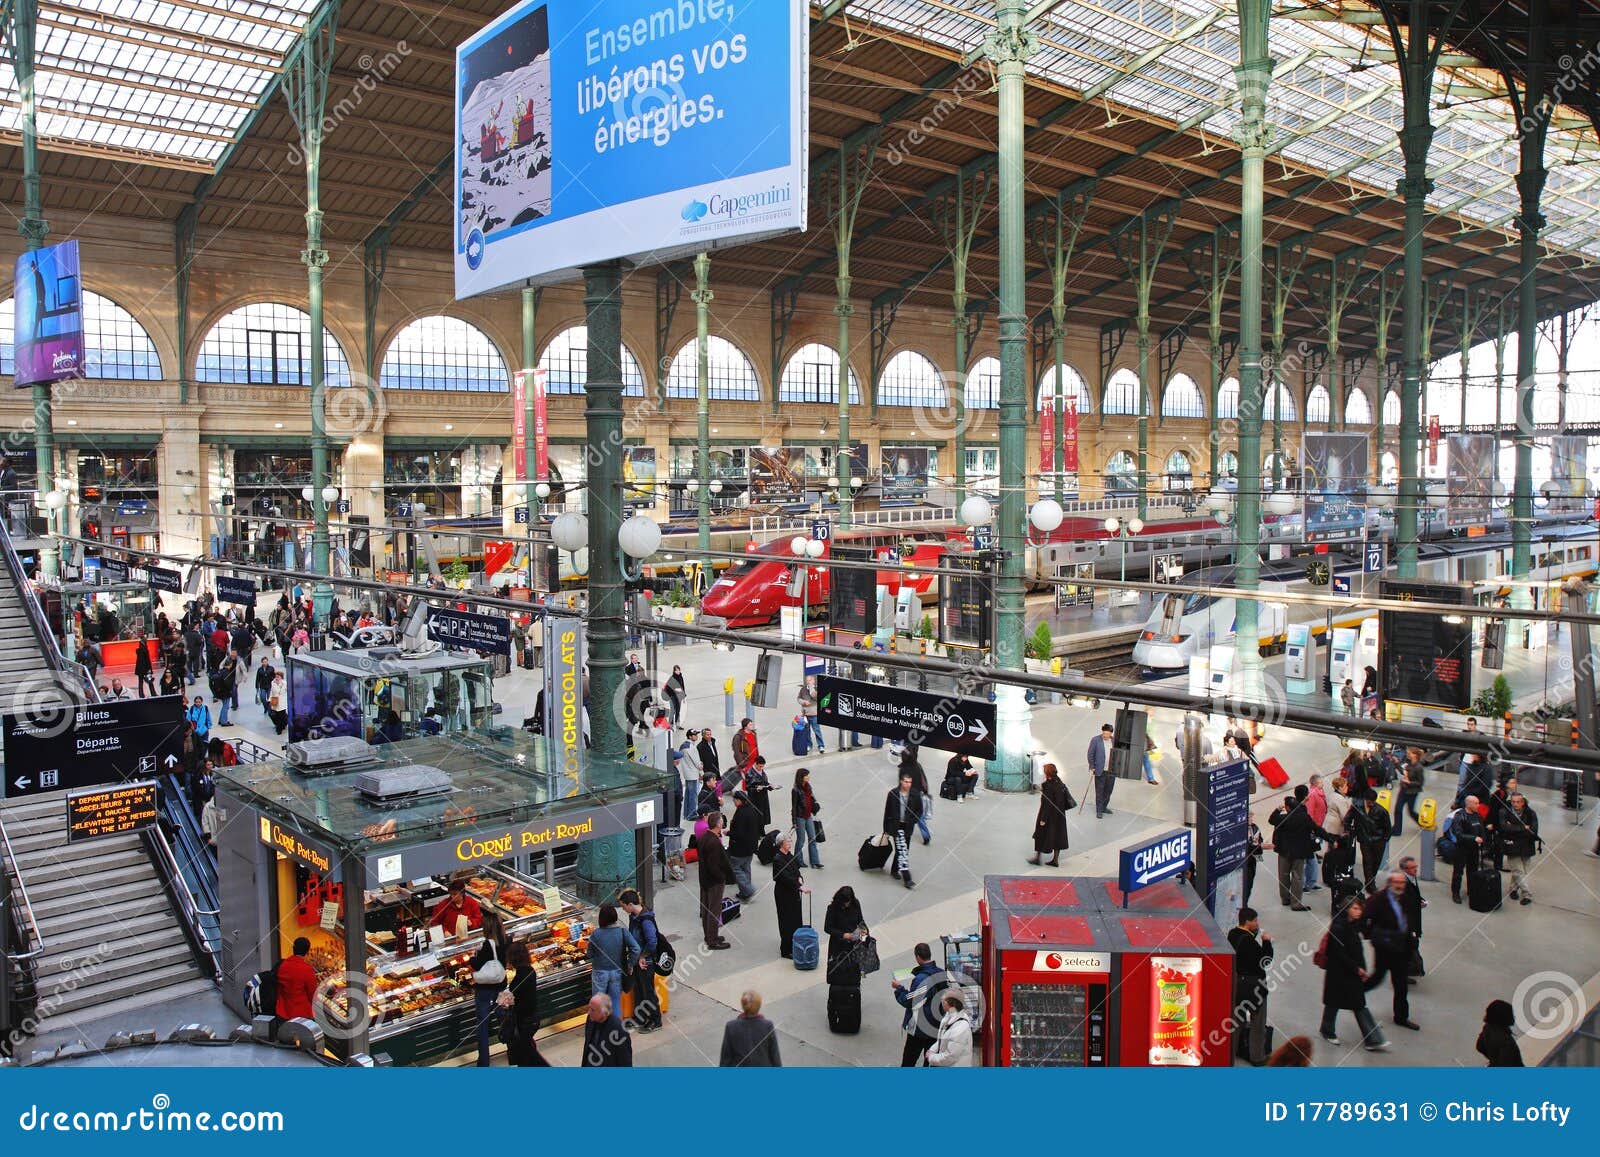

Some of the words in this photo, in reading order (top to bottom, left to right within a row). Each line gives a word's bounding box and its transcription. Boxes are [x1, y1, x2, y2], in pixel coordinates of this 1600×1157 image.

[585, 0, 736, 66] Ensemble,
[577, 52, 686, 115] libérons
[692, 33, 748, 75] vos
[594, 93, 726, 154] énergies.
[709, 181, 792, 219] Capgemini
[263, 500, 269, 508] 5
[340, 504, 346, 513] 6
[401, 507, 408, 516] 7
[519, 512, 526, 523] 8
[816, 526, 828, 540] 10
[1368, 552, 1380, 571] 12
[561, 631, 577, 744] CHOCOLATS
[76, 711, 110, 722] Billets
[856, 697, 885, 712] Réseau
[887, 702, 943, 723] Ile-de-France
[856, 711, 880, 722] Suburban
[881, 716, 893, 724] lines
[12, 727, 48, 736] eurostar
[949, 720, 963, 731] BUS
[76, 735, 120, 749] Départs
[79, 794, 110, 805] DEPARTS
[113, 788, 147, 799] EUROSTAR
[105, 806, 131, 817] GAUCHE
[130, 810, 156, 820] METERS
[118, 821, 135, 830] LEFT
[297, 842, 329, 871] Port-Royal
[1134, 834, 1188, 873] CHANGE
[1064, 957, 1101, 967] selecta
